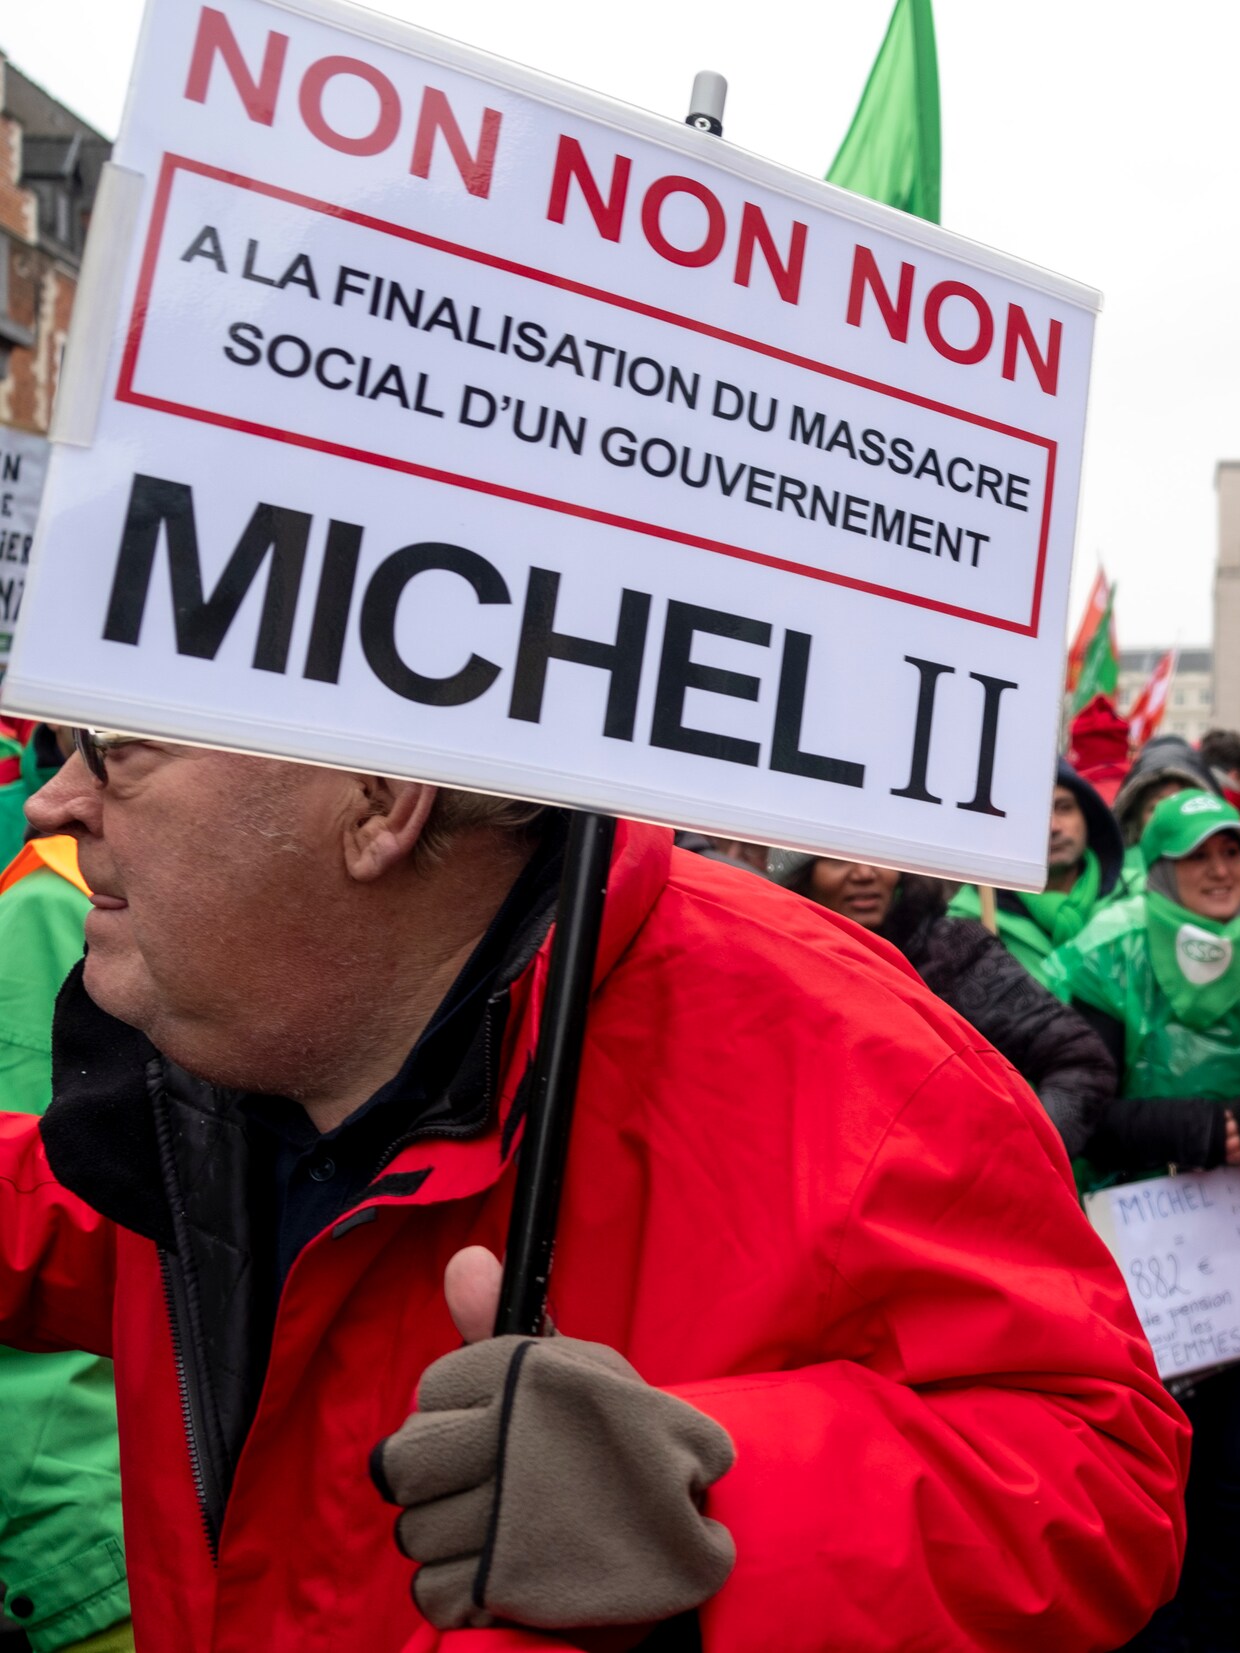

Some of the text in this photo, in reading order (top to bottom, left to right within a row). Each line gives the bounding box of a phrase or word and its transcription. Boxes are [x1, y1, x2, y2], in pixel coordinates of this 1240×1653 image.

[185, 8, 1063, 397] NON NON NON
[182, 226, 1030, 512] A LA FINALISATION DU MASSACRE
[224, 322, 990, 568] SOCIAL D’UN GOUVERNEMENT
[103, 474, 1018, 818] MICHEL II
[1131, 1254, 1214, 1300] 882 €
[1167, 1290, 1233, 1329] pension
